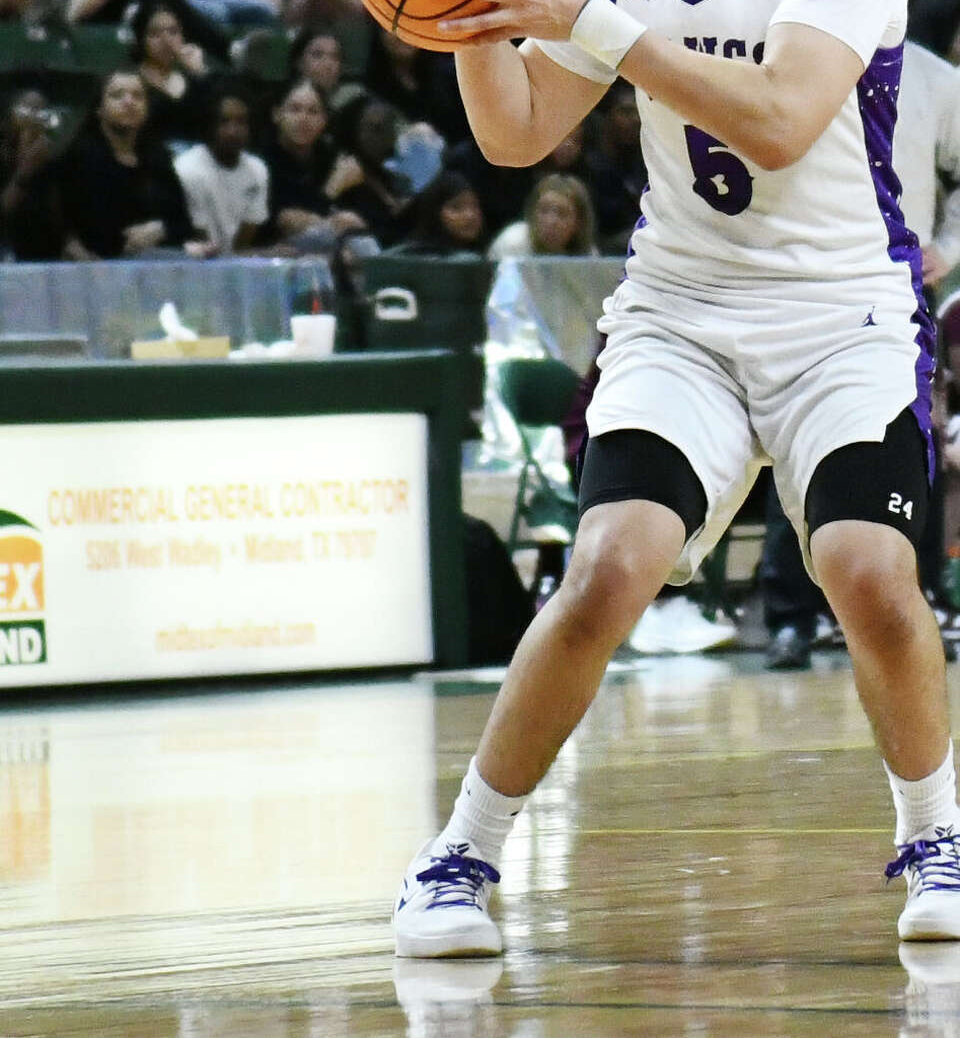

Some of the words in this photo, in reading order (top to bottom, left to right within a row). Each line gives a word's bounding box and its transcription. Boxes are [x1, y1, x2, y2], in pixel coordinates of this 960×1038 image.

[48, 487, 179, 526] COMMERCIAL
[184, 483, 275, 520] GENERAL
[280, 478, 409, 517] CONTRACTOR
[888, 492, 913, 520] 24
[311, 530, 329, 559] TX
[0, 627, 41, 663] ND
